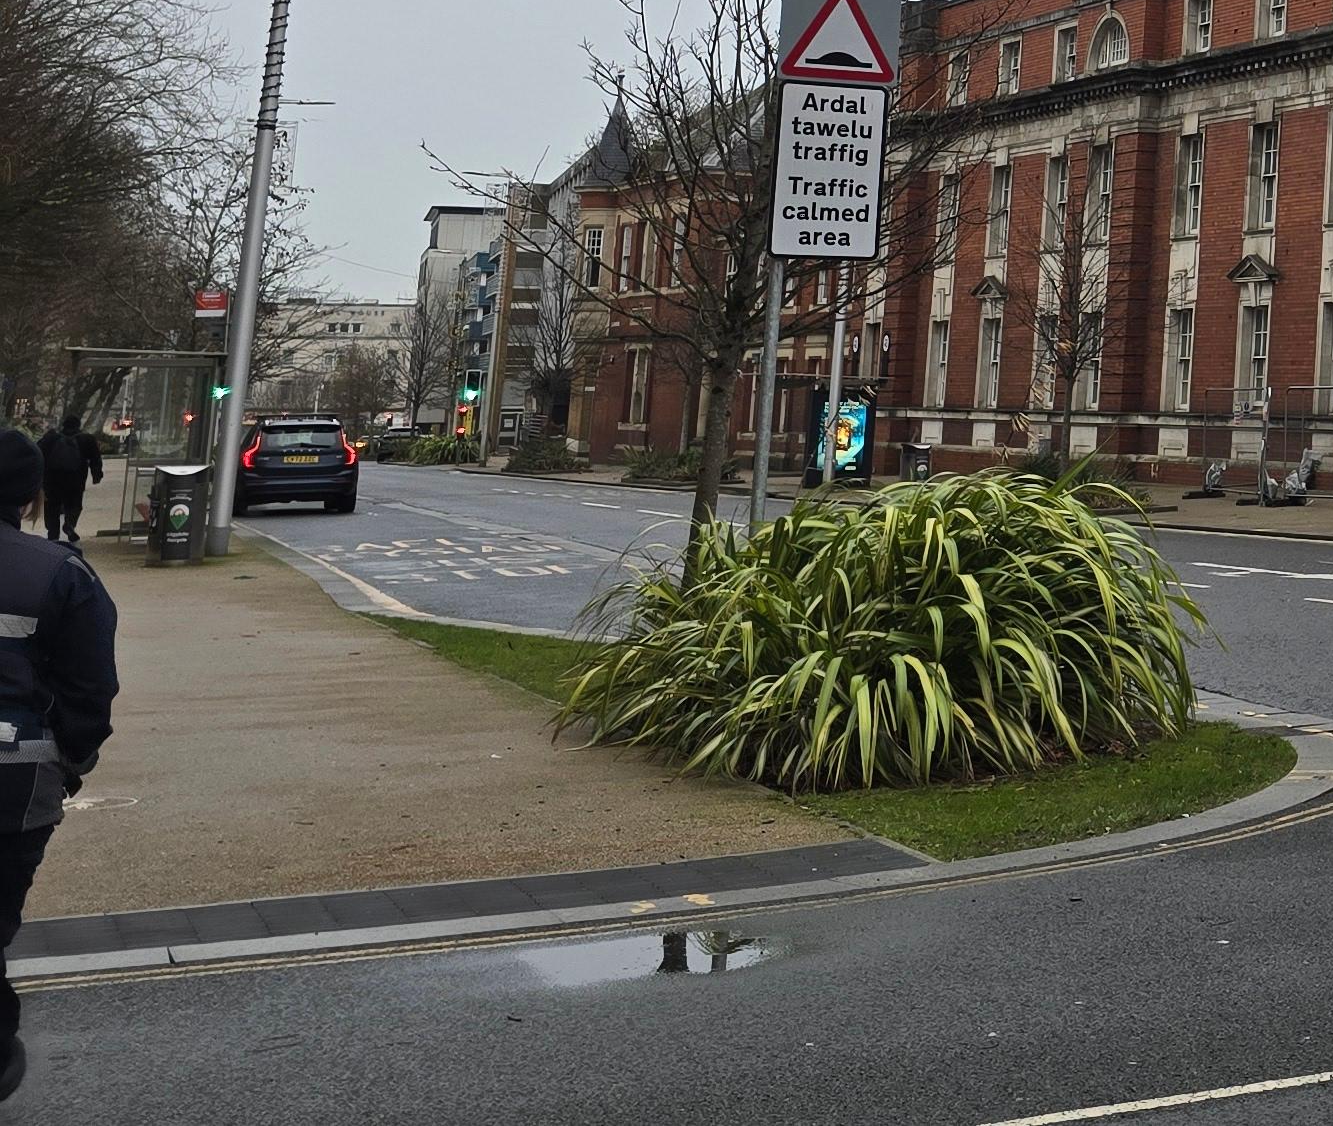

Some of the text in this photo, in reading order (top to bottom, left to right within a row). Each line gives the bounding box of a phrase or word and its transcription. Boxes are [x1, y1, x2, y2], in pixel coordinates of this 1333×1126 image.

[801, 92, 867, 115] Ardal
[791, 116, 873, 139] tawelu
[792, 140, 869, 166] traffig
[788, 176, 868, 198] Traffic
[782, 202, 870, 223] calmed
[798, 230, 851, 247] area
